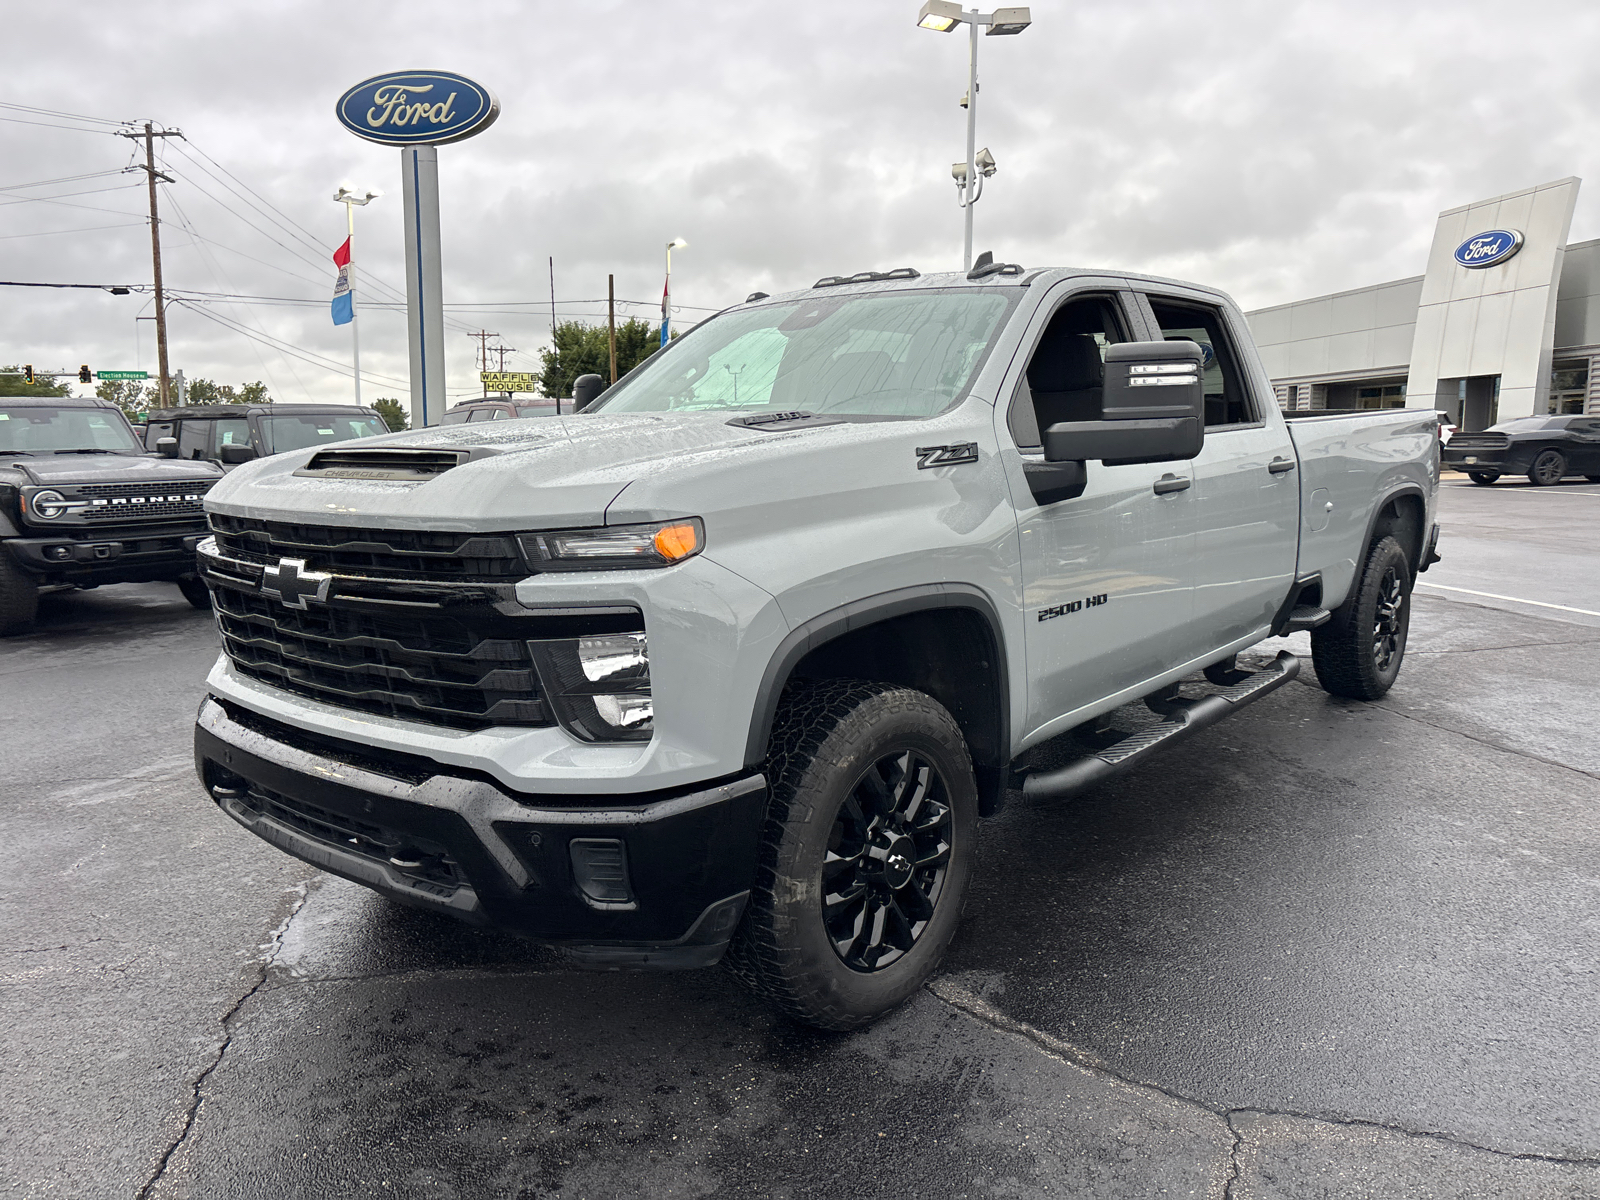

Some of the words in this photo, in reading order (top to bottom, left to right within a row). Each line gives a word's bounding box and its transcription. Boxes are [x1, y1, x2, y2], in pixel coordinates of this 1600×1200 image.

[366, 84, 458, 128] Ford
[1464, 236, 1503, 260] Ford
[916, 442, 979, 470] Z71
[324, 470, 395, 479] CHEVROLET
[92, 494, 198, 506] BRONCO
[1038, 600, 1082, 622] 2500
[1085, 593, 1108, 609] HD
